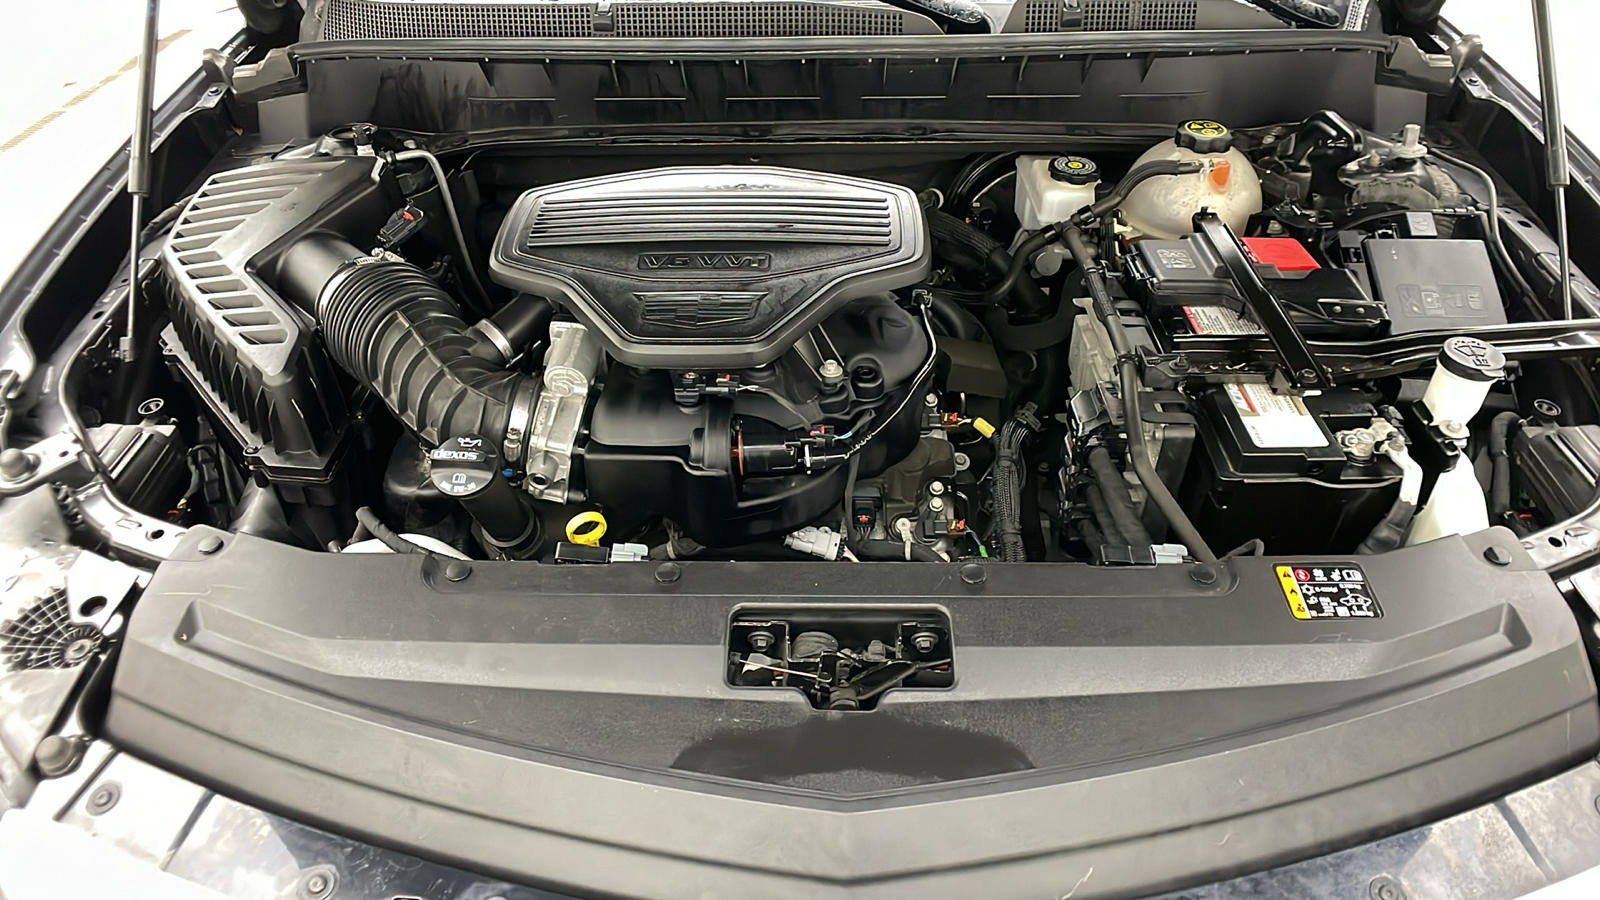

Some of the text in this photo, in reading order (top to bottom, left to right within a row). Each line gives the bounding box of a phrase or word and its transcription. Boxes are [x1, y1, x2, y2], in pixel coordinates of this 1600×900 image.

[643, 255, 767, 268] V6 VVT
[434, 449, 480, 460] dexos
